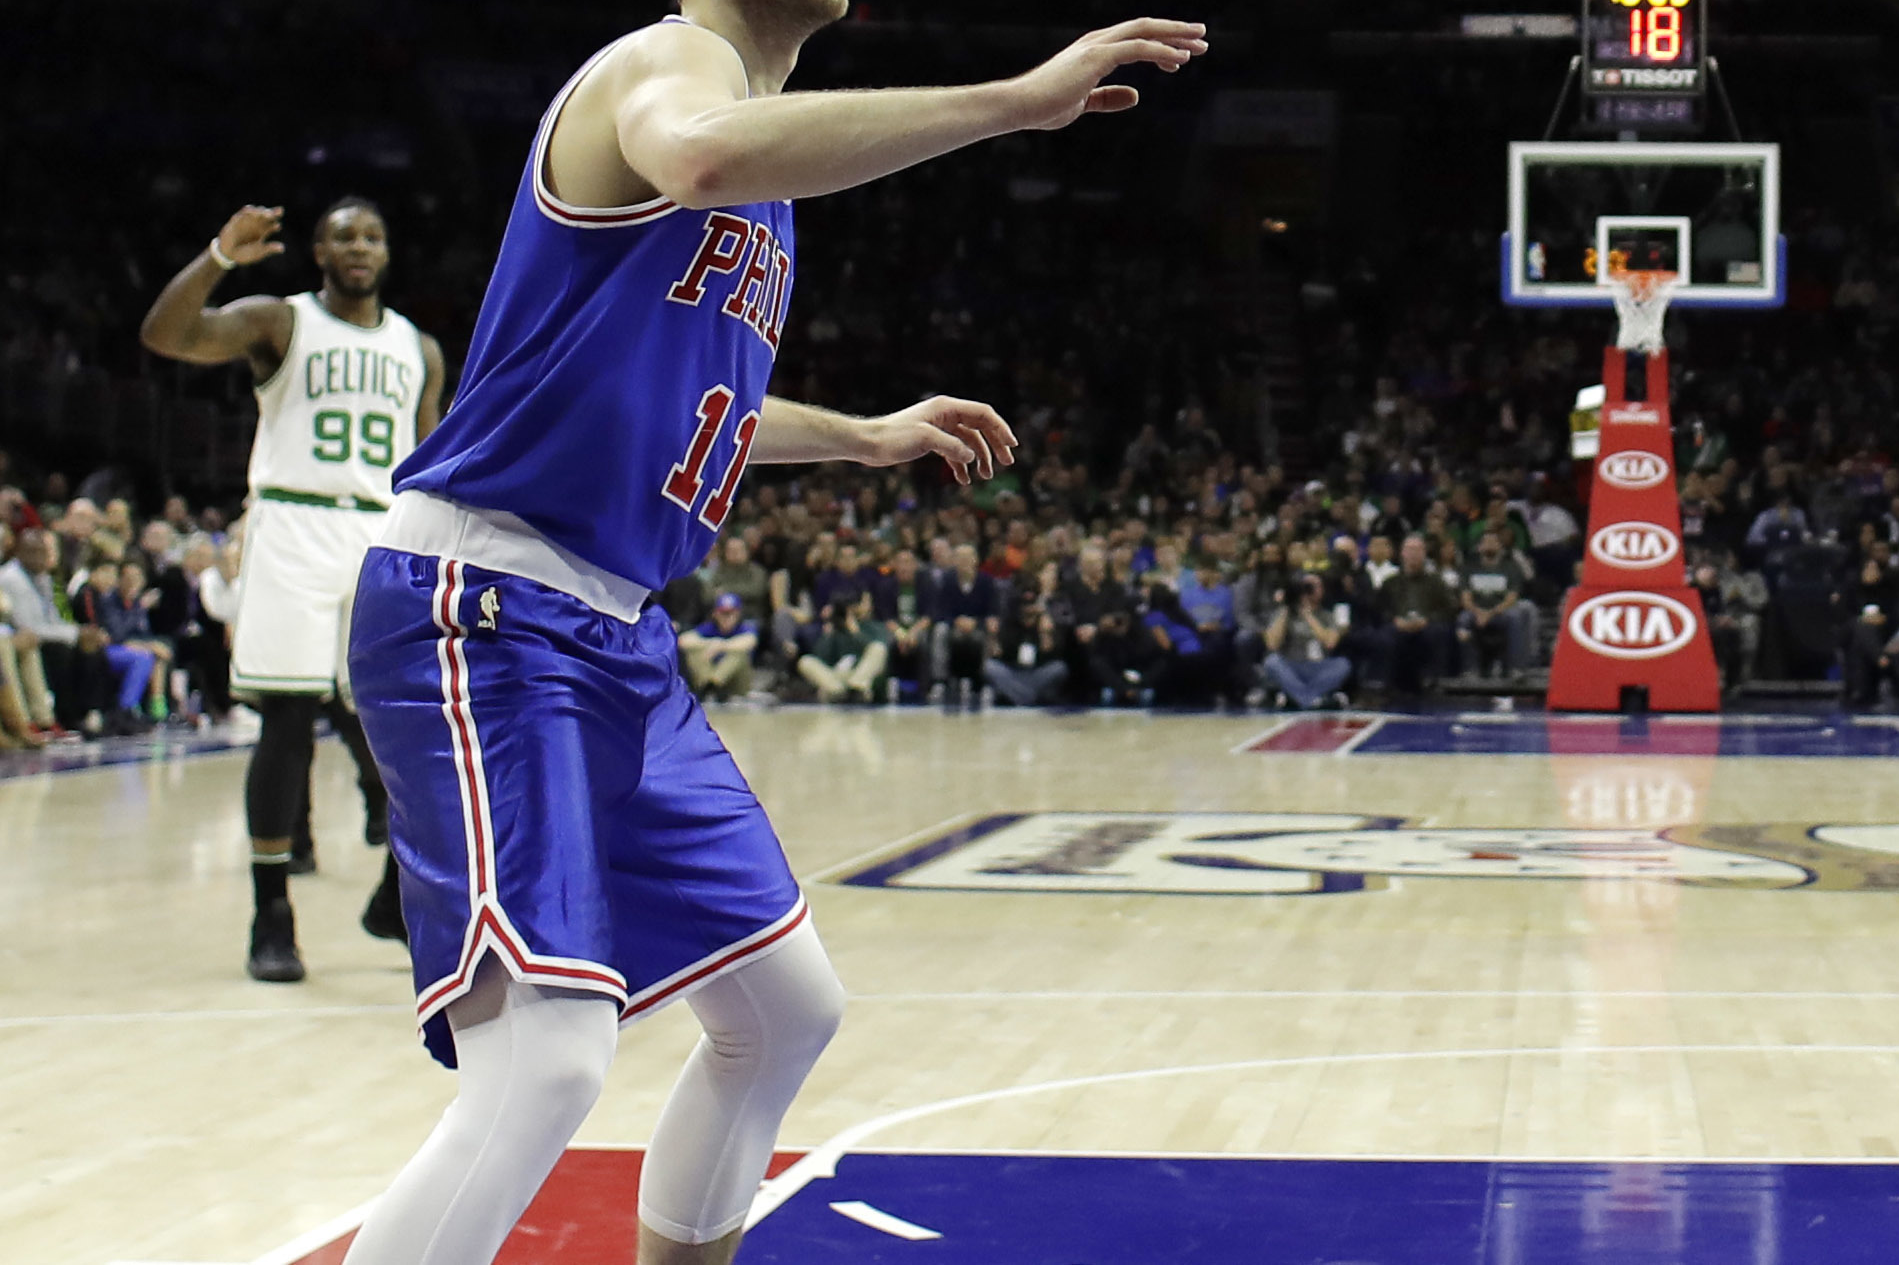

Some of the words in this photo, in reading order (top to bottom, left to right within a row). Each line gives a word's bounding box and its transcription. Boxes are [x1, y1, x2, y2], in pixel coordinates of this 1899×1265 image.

[1629, 5, 1682, 62] 18
[1620, 68, 1699, 87] TISSOT
[306, 347, 413, 410] CELTICS
[312, 409, 395, 469] 99
[661, 383, 762, 533] 11
[1611, 457, 1658, 478] KIA
[1603, 531, 1664, 559] KIA
[1591, 605, 1675, 643] KIA
